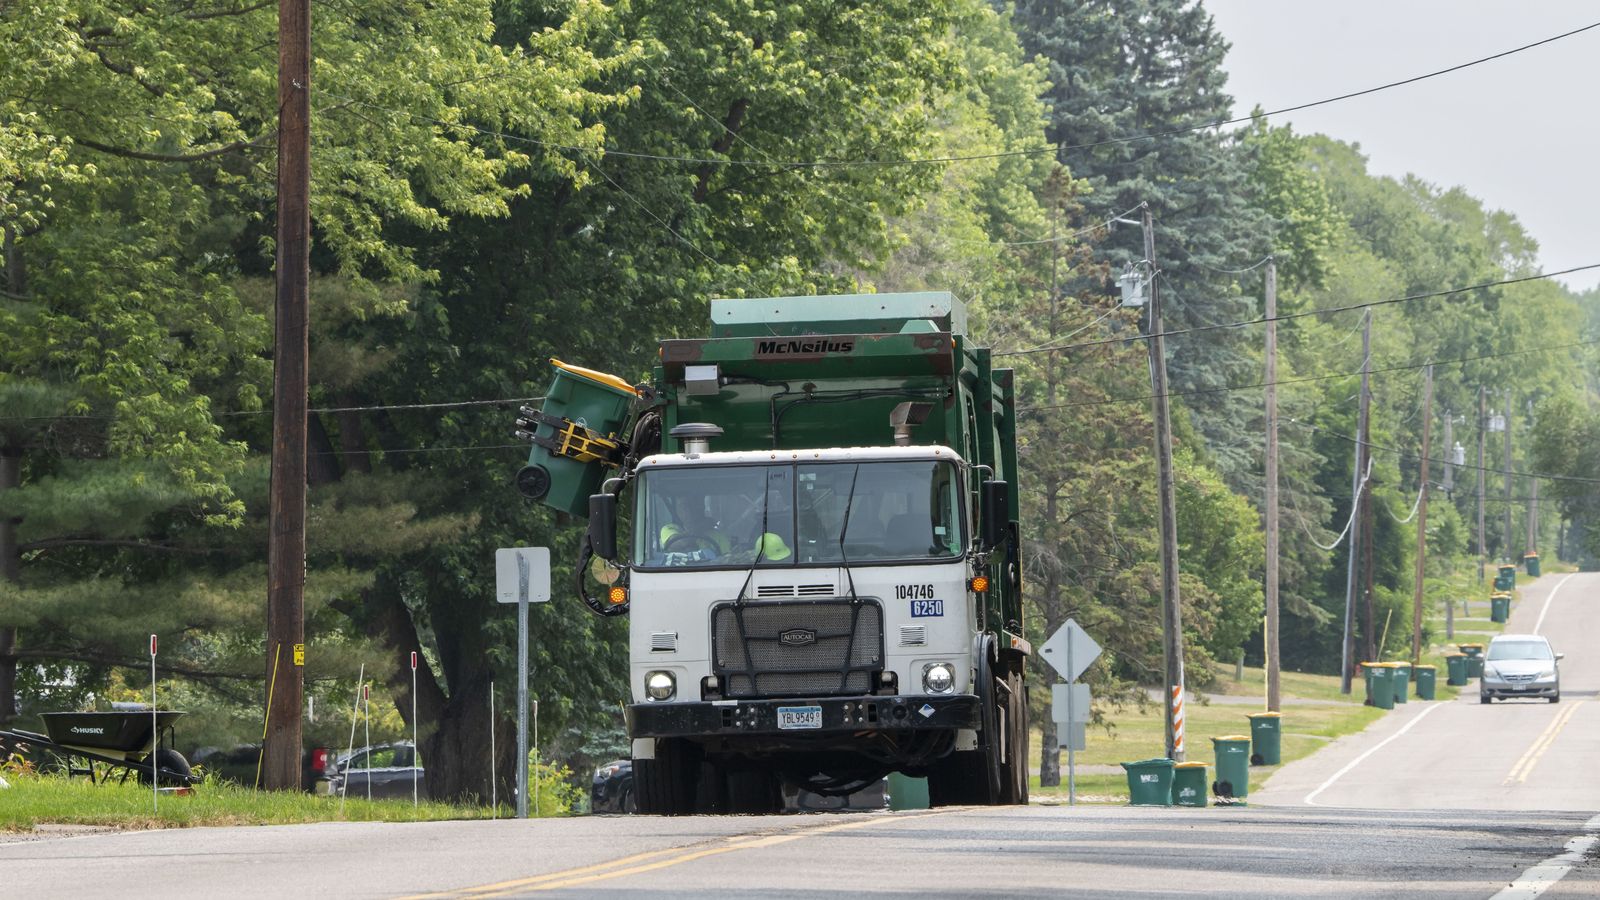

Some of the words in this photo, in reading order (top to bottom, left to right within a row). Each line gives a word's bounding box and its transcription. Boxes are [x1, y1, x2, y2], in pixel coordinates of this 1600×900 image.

[758, 340, 854, 354] McNeilus
[895, 584, 934, 600] 104746
[913, 600, 943, 616] 6250
[782, 712, 815, 724] YBL9549
